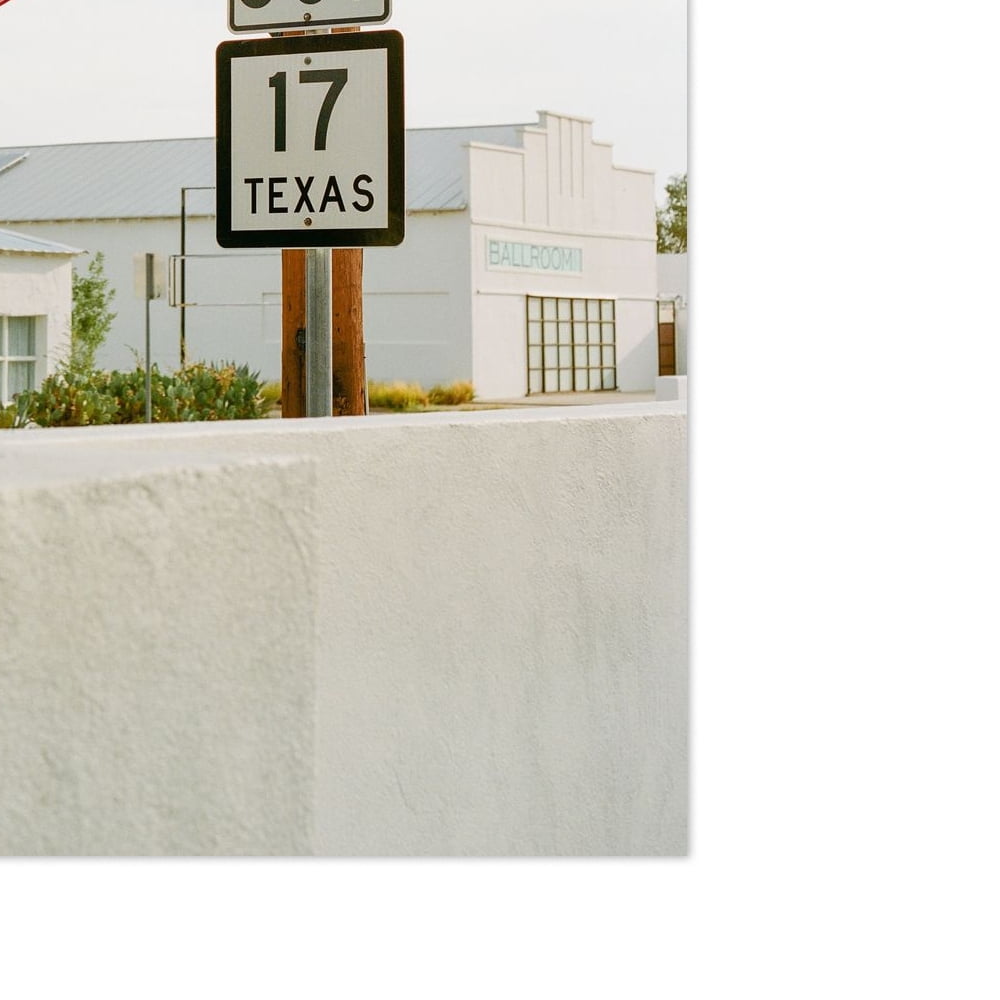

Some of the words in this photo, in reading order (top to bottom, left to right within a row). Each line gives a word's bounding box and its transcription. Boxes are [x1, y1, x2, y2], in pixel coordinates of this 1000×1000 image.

[268, 68, 348, 152] 17
[244, 174, 374, 214] TEXAS
[489, 240, 573, 271] BALLROOM
